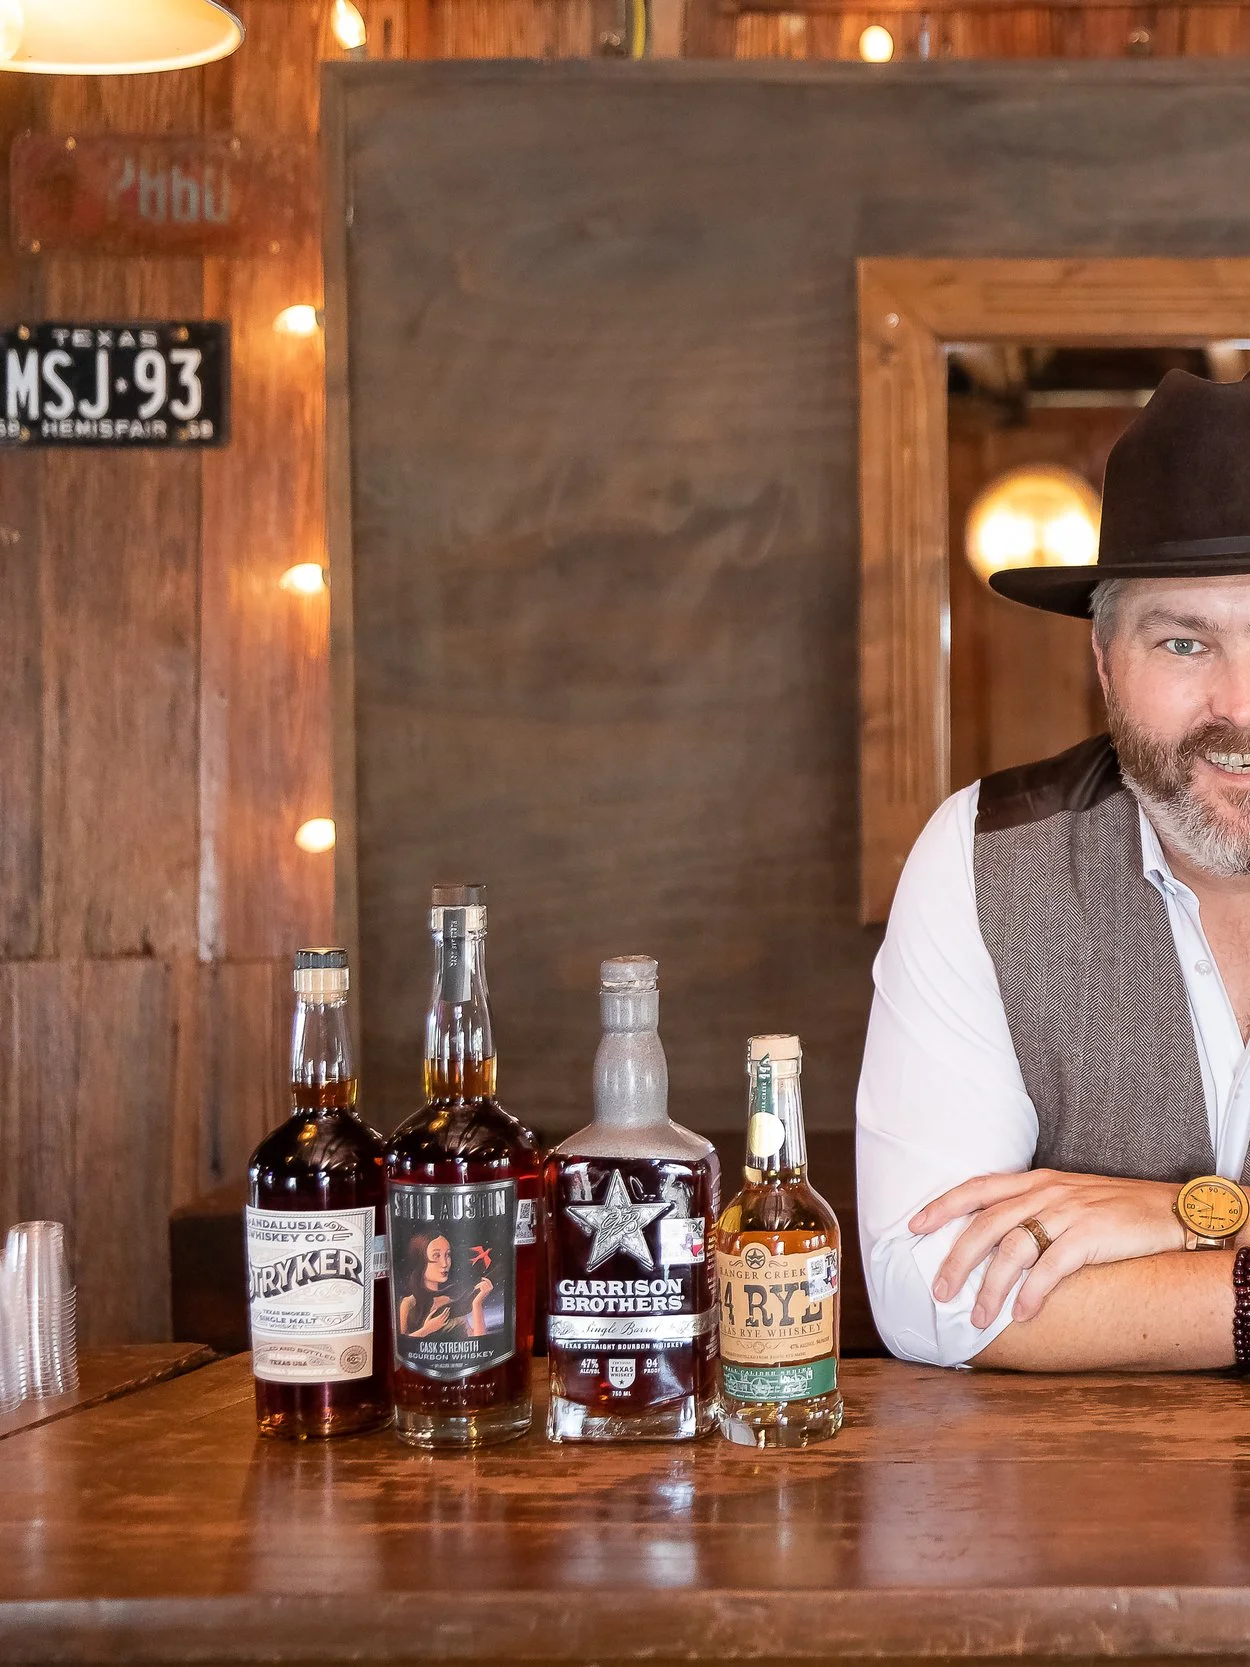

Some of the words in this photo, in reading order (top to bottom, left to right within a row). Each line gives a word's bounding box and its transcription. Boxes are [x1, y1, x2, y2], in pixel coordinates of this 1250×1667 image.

[52, 327, 158, 348] TEXAS
[41, 418, 168, 440] HEMISFAIR
[440, 1190, 506, 1221] AUSTIN
[251, 1219, 323, 1231] ANDALUSIA
[304, 1233, 330, 1242] CO.
[764, 1268, 806, 1279] CREEK
[558, 1278, 684, 1296] GARRISON
[560, 1295, 685, 1313] BROTHERS
[740, 1328, 760, 1337] RYE
[767, 1322, 821, 1338] WHISKEY
[420, 1341, 438, 1353] CASK
[440, 1340, 479, 1353] STRENGTH
[653, 1341, 684, 1350] WHISKEY
[408, 1352, 448, 1360] BOURBON
[451, 1350, 494, 1360] WHISKEY
[580, 1358, 599, 1368] 47%
[645, 1358, 658, 1368] 94
